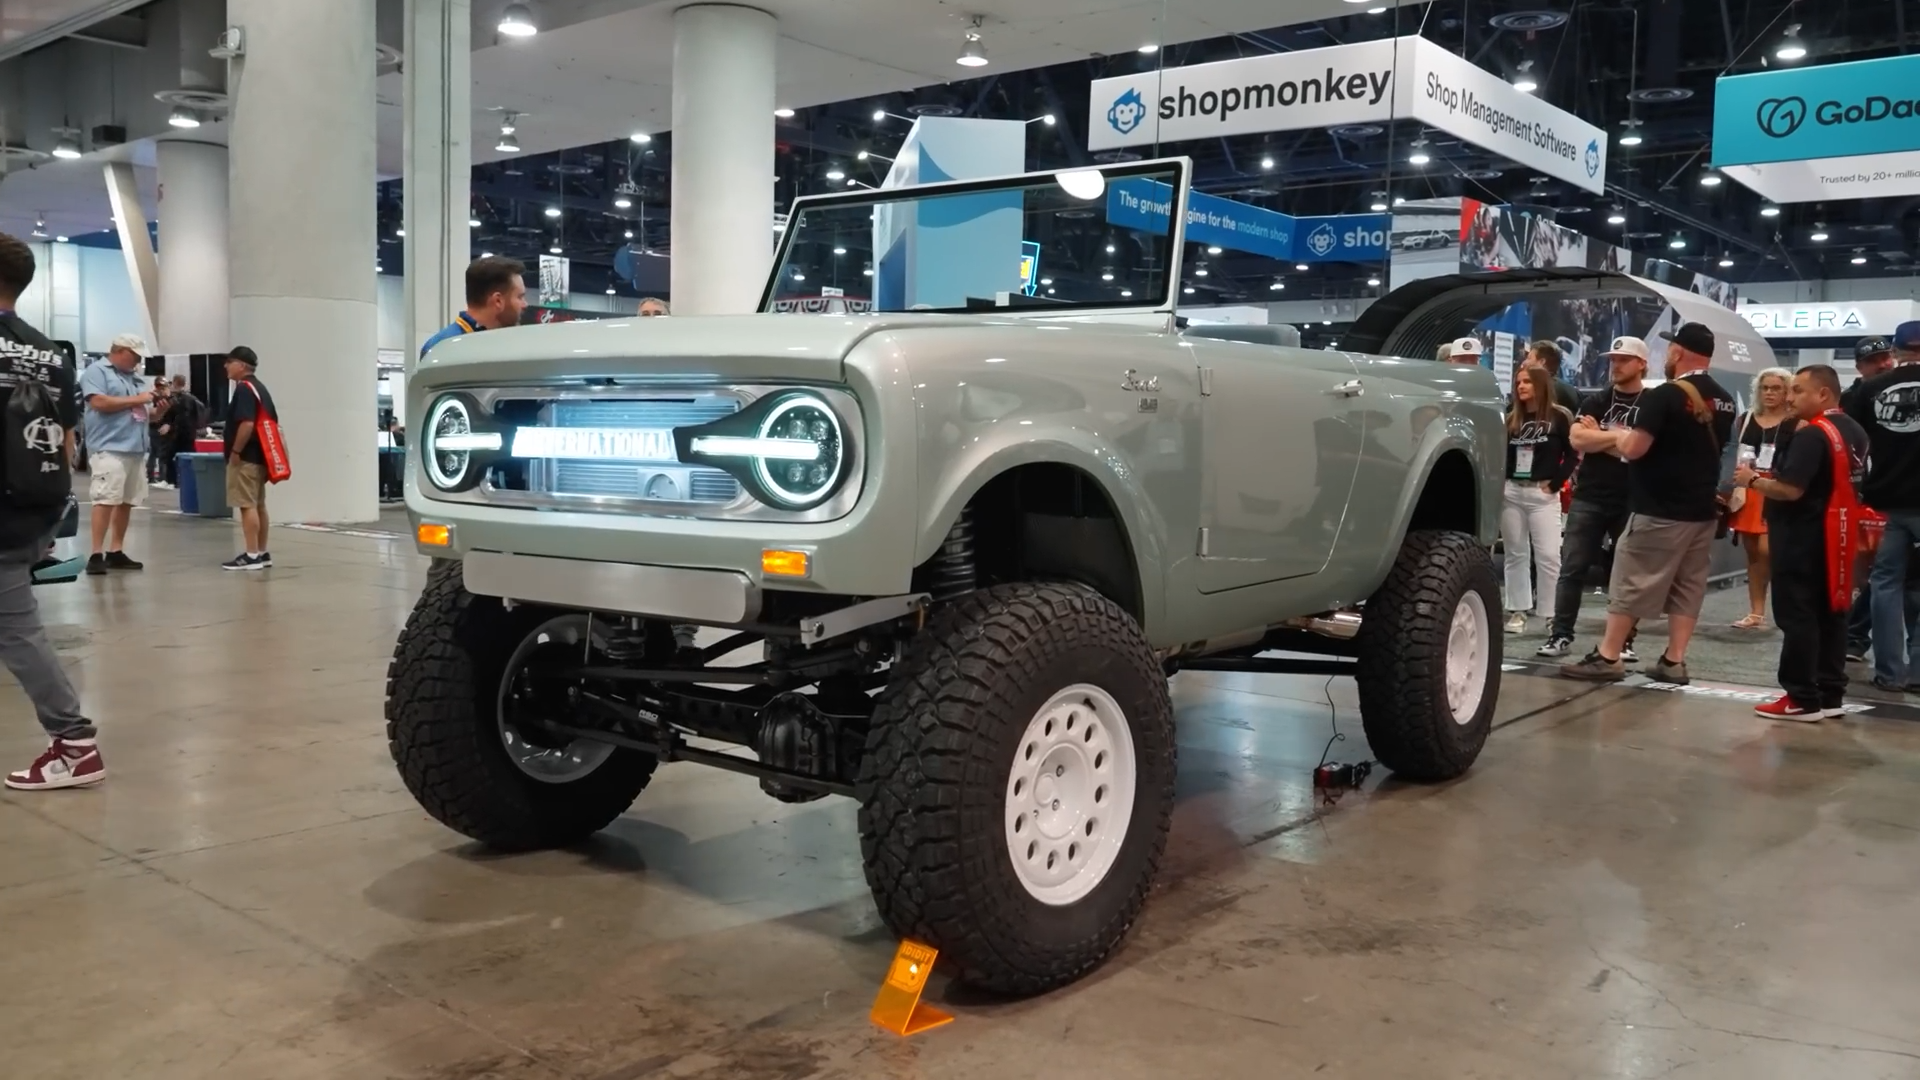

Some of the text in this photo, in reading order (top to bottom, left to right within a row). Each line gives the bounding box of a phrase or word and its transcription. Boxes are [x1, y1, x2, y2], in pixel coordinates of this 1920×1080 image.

[1159, 68, 1391, 121] shopmonkey
[1426, 71, 1577, 161] Shop Management Software
[1820, 174, 1856, 184] Trusted
[1857, 172, 1870, 183] by
[1873, 171, 1892, 181] 20+
[1119, 189, 1139, 209] The
[1186, 206, 1207, 224] gine
[1208, 211, 1221, 227] for
[1222, 215, 1236, 230] the
[1237, 221, 1269, 238] modern
[1269, 228, 1289, 245] shop
[1748, 311, 1862, 328] OLERA
[514, 431, 674, 458] TERNATIONAL
